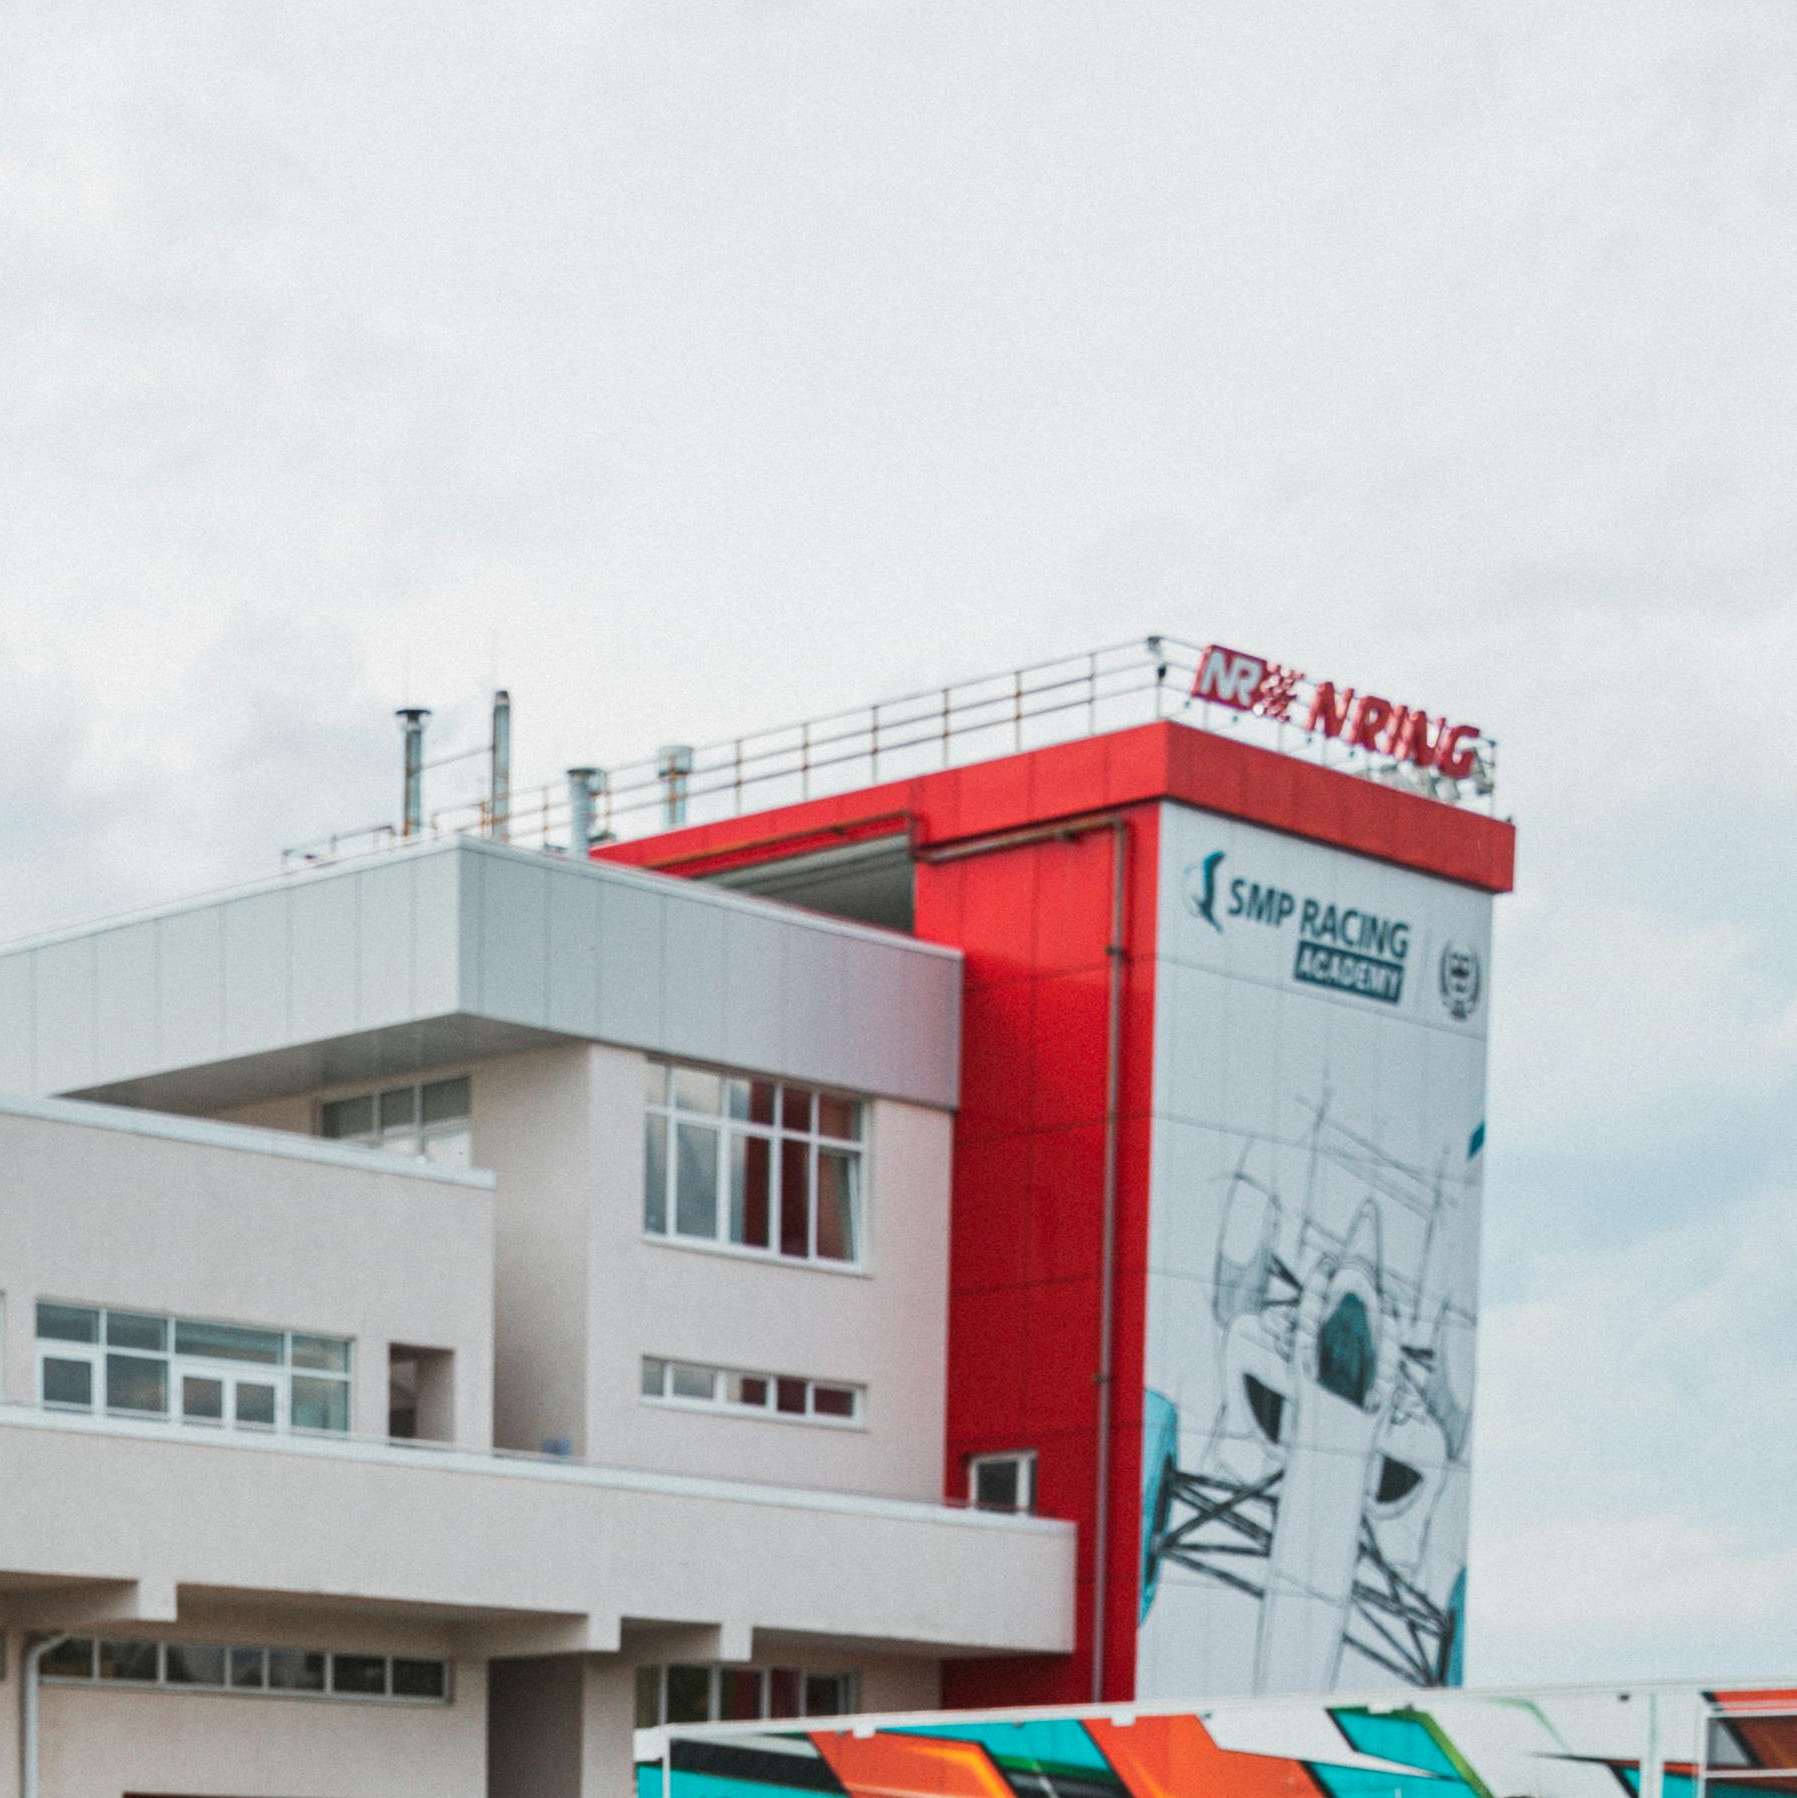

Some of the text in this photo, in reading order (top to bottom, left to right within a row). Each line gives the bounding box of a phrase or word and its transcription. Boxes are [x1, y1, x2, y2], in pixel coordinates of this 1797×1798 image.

[1306, 681, 1481, 781] NRING
[1227, 878, 1411, 961] SMP RACING
